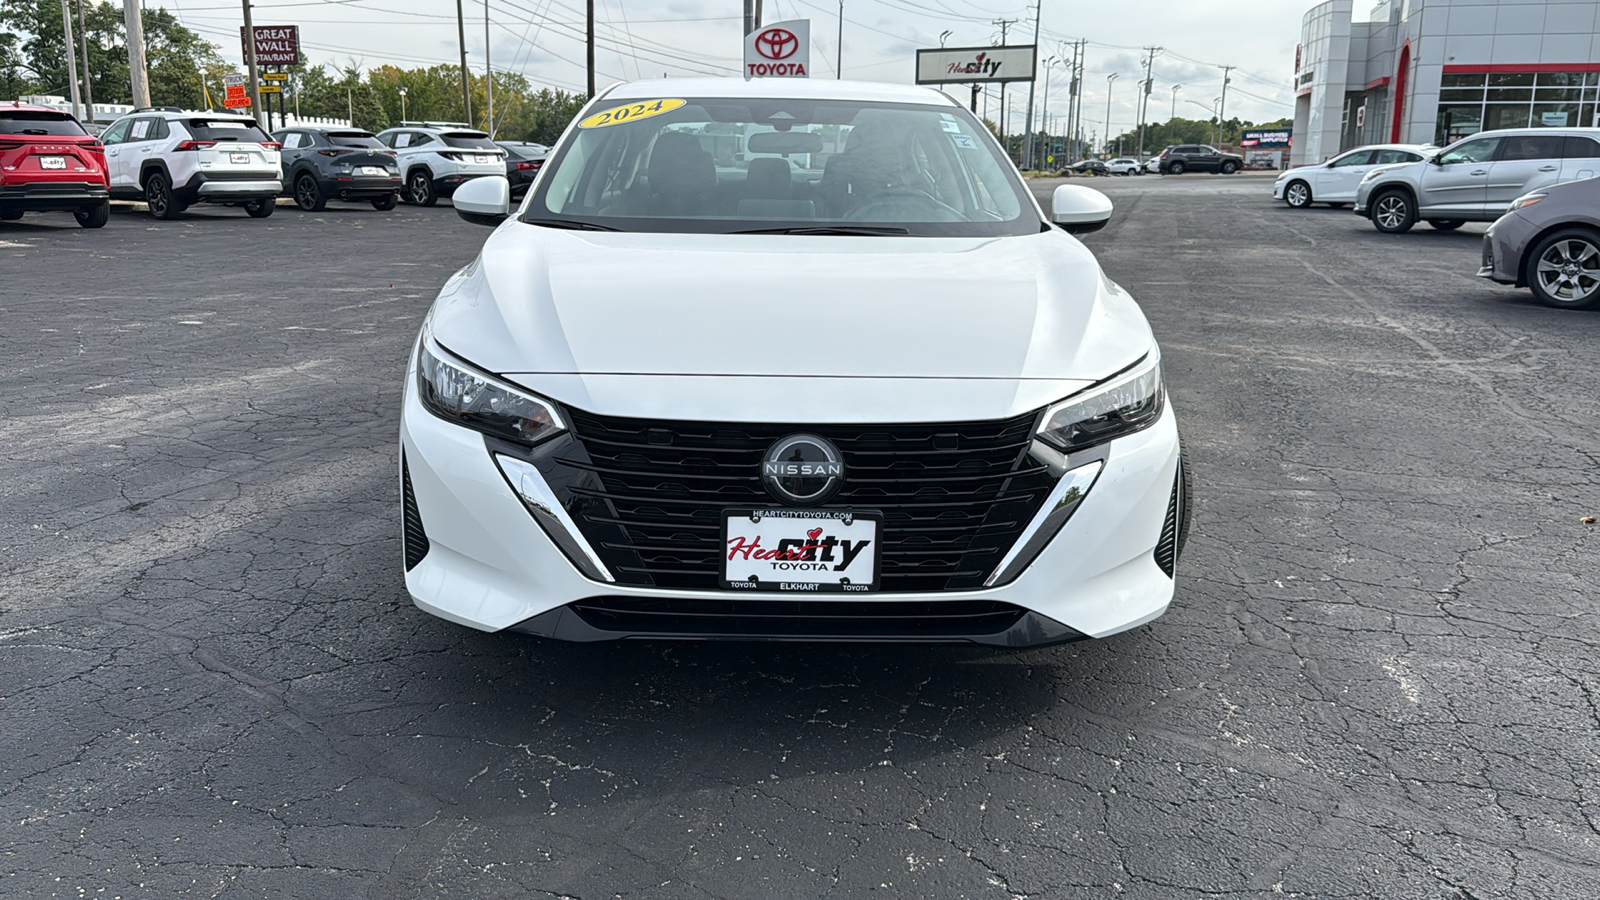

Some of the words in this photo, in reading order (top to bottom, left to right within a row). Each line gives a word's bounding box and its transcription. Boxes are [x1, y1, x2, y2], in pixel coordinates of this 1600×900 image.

[255, 29, 292, 39] GREAT
[256, 41, 292, 51] WALL
[245, 53, 295, 62] STAURANT
[747, 63, 806, 75] TOYOTA
[965, 58, 1002, 77] city
[596, 100, 664, 126] 2024
[766, 464, 840, 475] NISSAN
[753, 510, 853, 520] HEARTCITYTOYOTA.COM
[727, 535, 828, 561] Heart
[775, 536, 872, 572] city
[770, 562, 829, 571] TOYOTA
[780, 583, 820, 591] ELKHART
